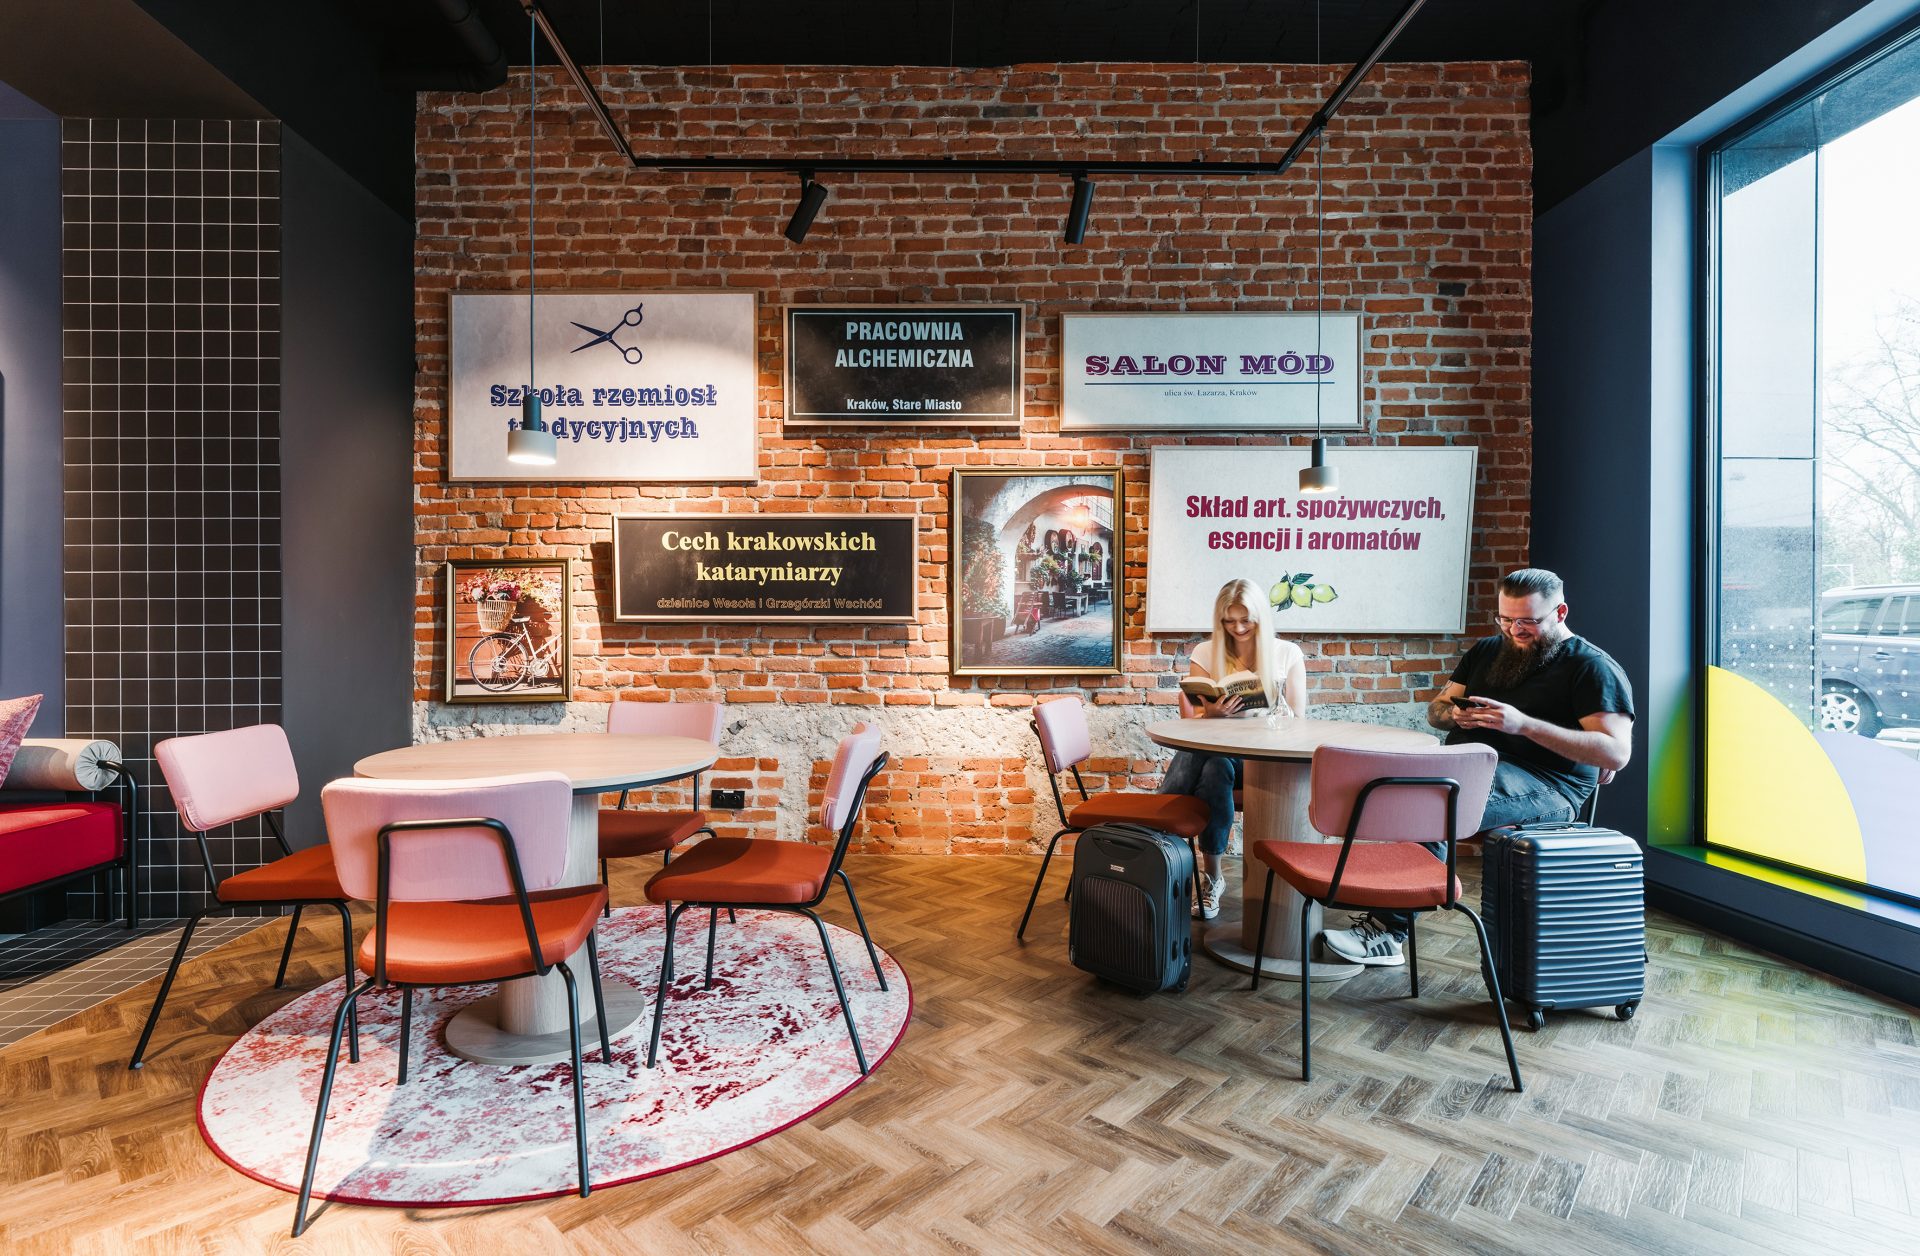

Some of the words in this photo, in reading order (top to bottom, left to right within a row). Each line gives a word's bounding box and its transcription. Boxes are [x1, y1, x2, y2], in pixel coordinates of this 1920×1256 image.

[846, 321, 963, 341] PRACOWNIA
[834, 349, 974, 368] ALCHEMICZNA
[1085, 354, 1227, 376] SALON
[1239, 350, 1335, 375] MÓD
[592, 384, 717, 407] rzemiosł
[846, 398, 889, 412] Kraków,
[892, 398, 922, 410] Stare
[924, 398, 962, 410] Miasto
[508, 416, 699, 443] tdycyjnych
[1186, 495, 1249, 518] Skład
[1253, 497, 1291, 519] art.
[1296, 495, 1446, 521] spożywczych,
[661, 531, 721, 551] Cech
[726, 531, 877, 551] krakowskich
[1208, 528, 1290, 552] esencji
[1295, 528, 1304, 550] i
[1307, 528, 1422, 551] aromatów
[695, 562, 843, 586] kataryniarzy
[656, 597, 710, 609] dzielnice
[712, 597, 756, 609] Wesoła
[758, 598, 763, 609] i
[765, 597, 831, 611] Grzegórzki
[833, 597, 883, 609] Wschód
